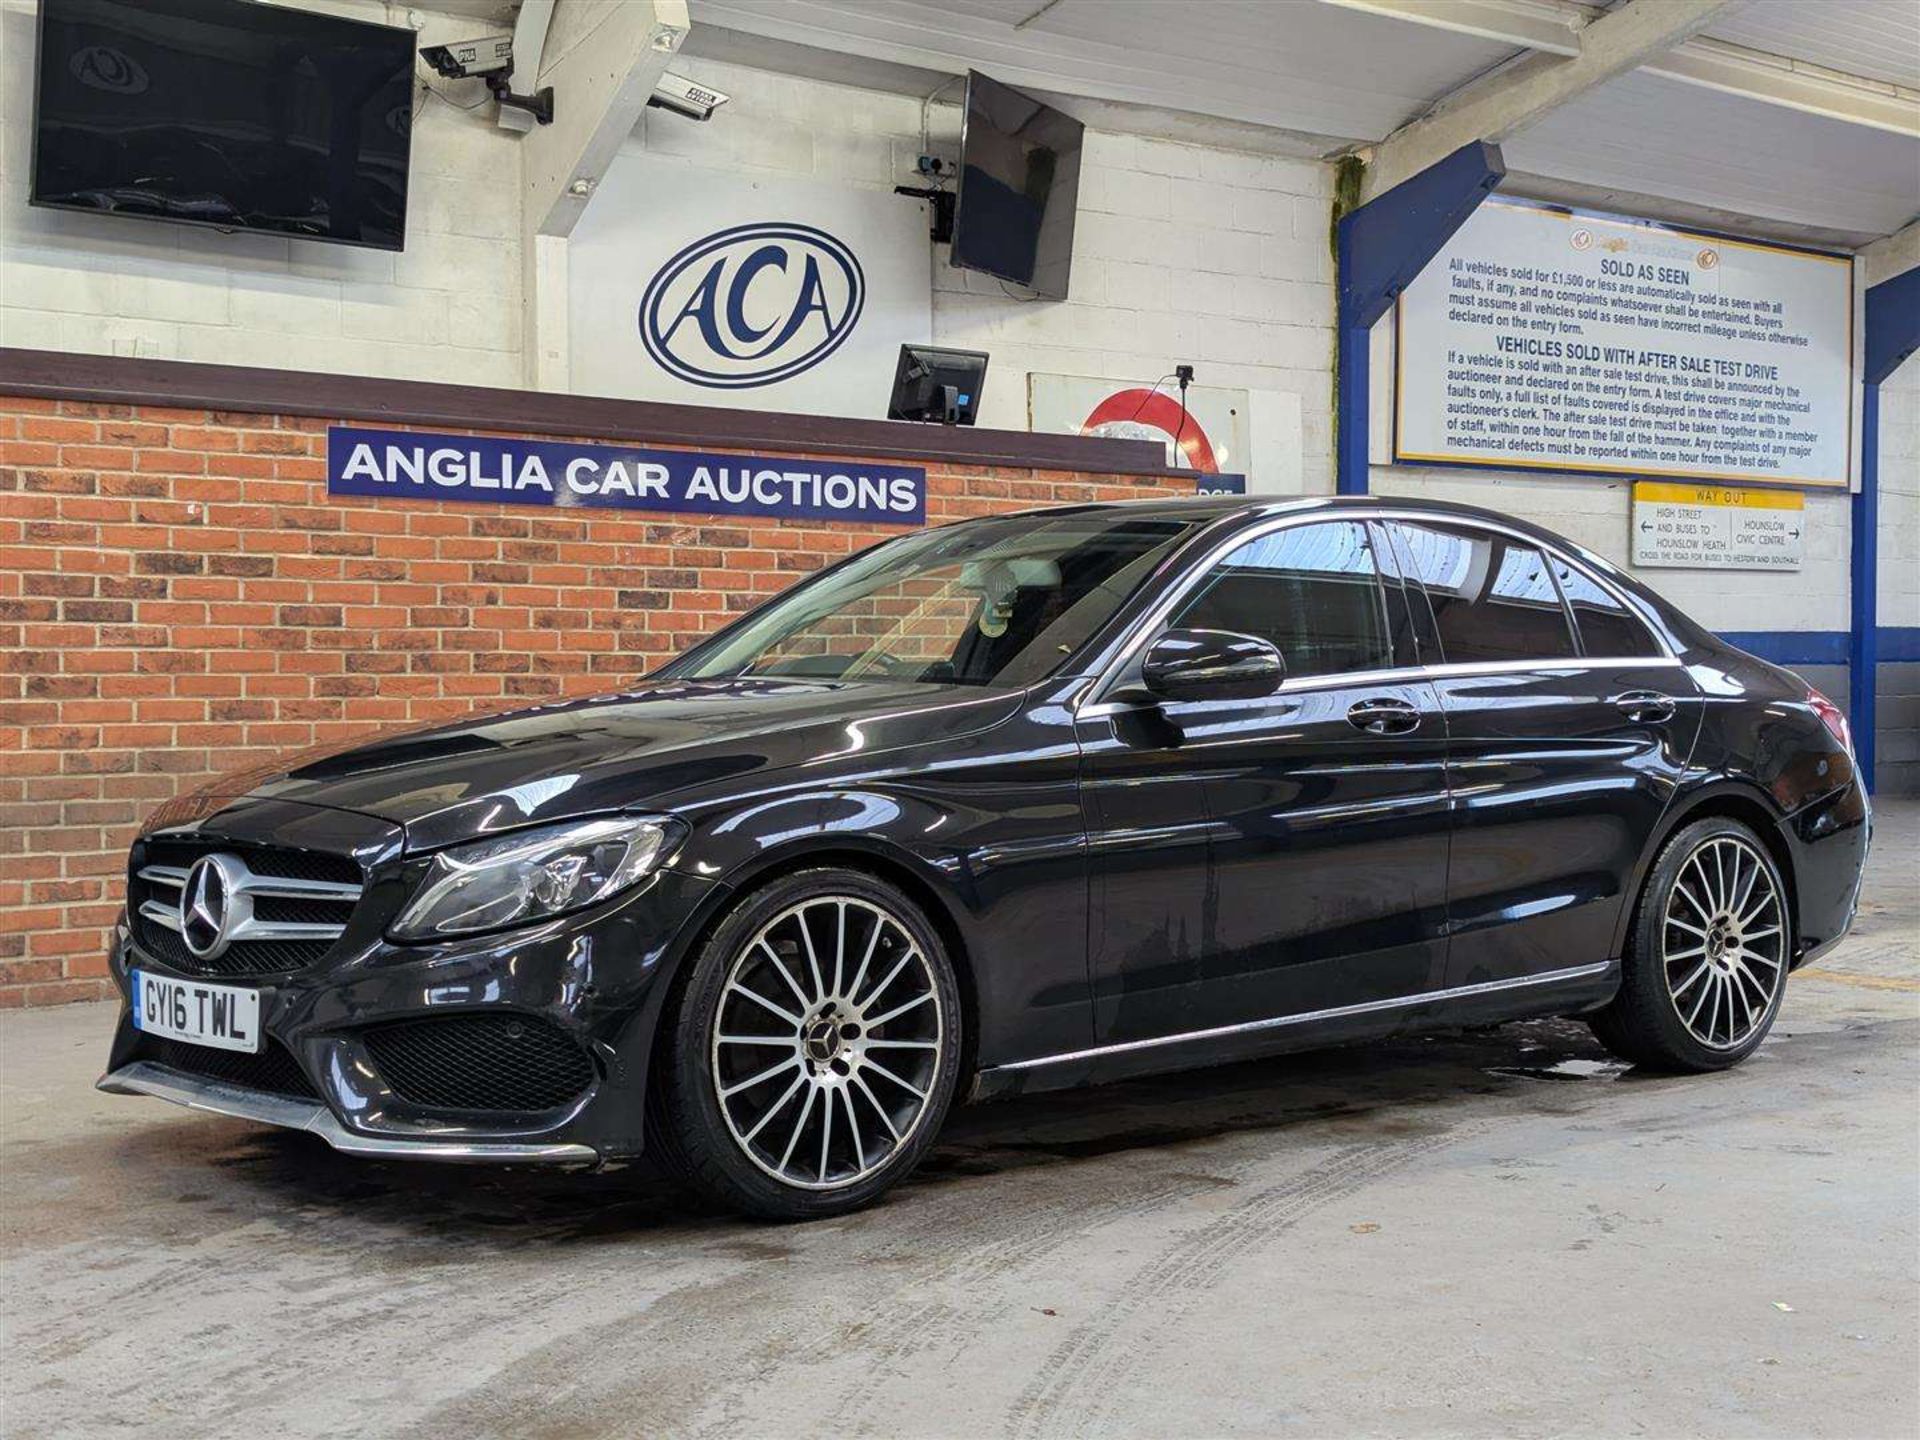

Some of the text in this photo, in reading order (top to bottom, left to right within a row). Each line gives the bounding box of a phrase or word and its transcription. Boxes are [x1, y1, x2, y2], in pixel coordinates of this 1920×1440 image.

[1449, 258, 1463, 272] All
[1466, 262, 1508, 278] vehicles
[1511, 268, 1532, 281] sold
[1536, 270, 1548, 283] for
[1598, 278, 1617, 292] less
[1620, 284, 1634, 294] are
[1636, 286, 1696, 305] automatically
[1698, 293, 1716, 305] sold
[1732, 299, 1751, 309] seen
[1754, 300, 1770, 312] with
[1772, 302, 1782, 313] all
[1601, 259, 1634, 278] SOLD
[1658, 267, 1689, 285] SEEN
[661, 244, 836, 360] ACA
[1449, 294, 1474, 305] must
[1478, 297, 1516, 310] assume
[1520, 300, 1532, 312] all
[1534, 303, 1575, 317] vehicles
[1578, 308, 1598, 320] sold
[1614, 314, 1635, 325] seen
[1638, 314, 1658, 327] have
[1662, 317, 1700, 333] incorrect
[1704, 323, 1736, 339] mileage
[1739, 328, 1766, 340] unless
[1768, 331, 1808, 346] otherwise
[1520, 286, 1538, 297] and
[1556, 291, 1608, 306] complaints
[1611, 297, 1662, 313] whatsoever
[1665, 303, 1686, 316] shall
[1754, 314, 1783, 329] Buyers
[1448, 308, 1494, 324] declared
[1512, 316, 1528, 328] the
[1530, 320, 1556, 334] entry
[1467, 354, 1502, 367] vehicle
[1518, 359, 1540, 371] sold
[1542, 361, 1562, 373] with
[1580, 365, 1601, 377] after
[1604, 368, 1622, 379] sale
[1625, 370, 1642, 381] test
[1672, 375, 1688, 386] this
[1692, 377, 1712, 388] shall
[1728, 383, 1772, 394] announced
[1787, 387, 1800, 397] the
[1496, 335, 1778, 380] VEHICLES SOLD WITH AFTER SALE TEST DRIVE
[1448, 370, 1502, 384] auctioneer
[1504, 375, 1524, 386] and
[1526, 375, 1568, 390] declared
[1586, 381, 1600, 393] the
[1603, 385, 1626, 398] entry
[1664, 389, 1681, 400] test
[1684, 390, 1706, 402] drive
[1708, 395, 1737, 405] covers
[1739, 397, 1762, 410] major
[1764, 400, 1810, 412] mechanical
[1448, 384, 1476, 398] faults
[1514, 391, 1530, 403] full
[1534, 392, 1548, 404] list
[1564, 395, 1590, 408] faults
[1592, 400, 1629, 411] covered
[1642, 402, 1685, 418] displayed
[1698, 408, 1712, 418] the
[1714, 409, 1738, 420] office
[1741, 412, 1756, 422] and
[1758, 414, 1775, 424] with
[1777, 415, 1791, 425] the
[1489, 421, 1519, 434] within
[1522, 426, 1540, 436] one
[1544, 425, 1566, 438] hour
[1568, 427, 1590, 439] from
[1592, 429, 1607, 441] the
[1610, 430, 1624, 442] fall
[1638, 432, 1652, 444] the
[1695, 437, 1711, 451] Any
[1714, 440, 1760, 453] complaints
[1789, 445, 1812, 458] major
[1542, 409, 1560, 421] The
[1564, 411, 1585, 423] after
[1588, 414, 1607, 425] sale
[1609, 416, 1626, 426] test
[1629, 416, 1652, 428] drive
[1654, 421, 1677, 430] must
[1692, 423, 1716, 433] taken
[1722, 425, 1756, 438] together
[1759, 428, 1776, 438] with
[1785, 431, 1818, 442] member
[1448, 436, 1505, 449] mechanical
[1508, 439, 1544, 452] defects
[1548, 444, 1572, 453] must
[1588, 447, 1628, 458] reported
[1630, 448, 1658, 459] within
[1660, 452, 1676, 460] one
[1678, 451, 1699, 462] hour
[1702, 452, 1722, 464] from
[1724, 454, 1738, 465] the
[1740, 456, 1756, 466] test
[341, 444, 918, 513] ANGLIA CAR AUCTIONS
[1696, 490, 1747, 504] WAY OUT
[1656, 509, 1702, 518] HIGH STREET
[1658, 524, 1711, 535] AND BUSES TO
[1744, 521, 1785, 532] HOUNSLOW
[1656, 538, 1726, 550] HOUNSLOW HEATH
[1736, 534, 1785, 545] CIVIC CENTRE
[146, 980, 246, 1040] GY16 TWL
